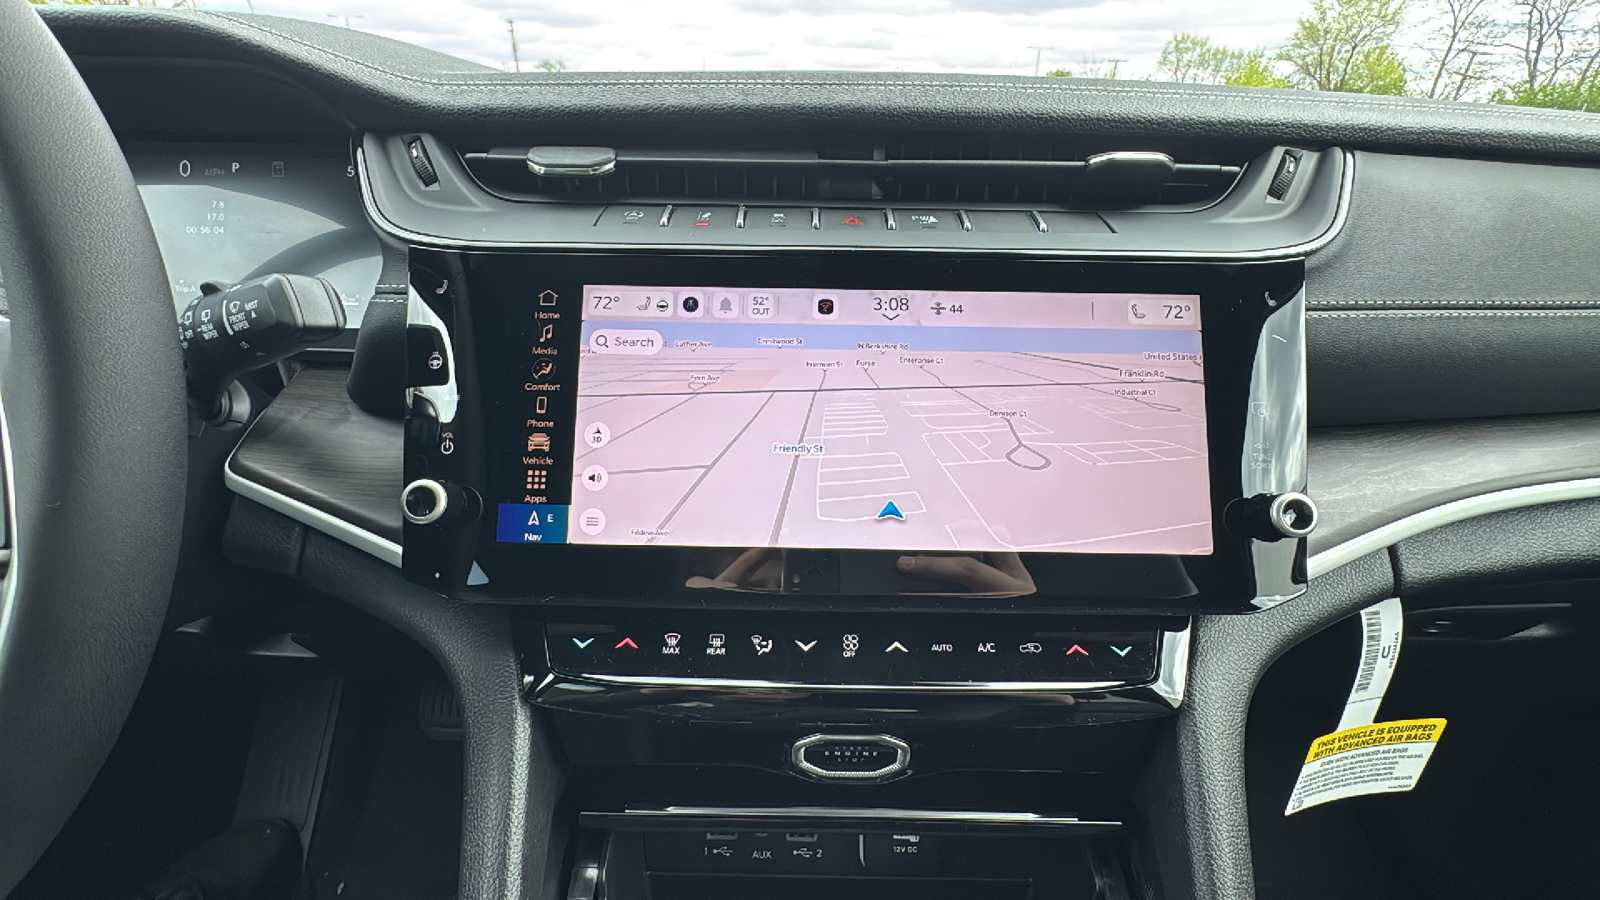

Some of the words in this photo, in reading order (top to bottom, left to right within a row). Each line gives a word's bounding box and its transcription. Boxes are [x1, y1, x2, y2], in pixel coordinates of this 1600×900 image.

[179, 159, 191, 177] 0
[204, 168, 225, 176] MPH
[231, 162, 240, 174] P
[211, 200, 225, 209] 7.8
[206, 212, 225, 221] 17.0
[175, 285, 189, 294] Trip
[190, 285, 197, 293] A
[873, 297, 909, 312] 3:08
[949, 304, 964, 314] 44
[534, 311, 561, 320] Home
[752, 307, 770, 316] OUT
[228, 311, 246, 324] FRONT
[614, 336, 654, 348] Search
[531, 347, 558, 356] Media
[899, 356, 935, 364] Enterprise
[1144, 353, 1171, 361] United
[1172, 353, 1198, 361] States
[1119, 369, 1152, 378] Franklin
[1153, 370, 1165, 378] Rd
[524, 382, 561, 392] Comfort
[989, 409, 1015, 418] Denison
[1017, 409, 1027, 418] Ct
[526, 419, 554, 428] Phone
[591, 436, 602, 444] 3D
[773, 444, 812, 454] Friendly
[813, 444, 824, 454] St
[522, 456, 554, 466] Vehicle
[524, 494, 548, 504] Apps
[547, 514, 554, 522] E
[524, 532, 543, 542] Nav
[662, 646, 681, 655] MAX
[706, 647, 726, 656] REAR
[931, 643, 954, 653] AUTO
[977, 642, 996, 653] A/C
[842, 650, 856, 658] OFF
[1316, 738, 1337, 750] THIS
[1338, 729, 1375, 743] VEHICLE
[1375, 728, 1386, 736] IS
[1386, 724, 1438, 735] EQUIPPED
[1313, 746, 1336, 760] WITH
[1336, 737, 1386, 753] ADVANCED
[1387, 733, 1405, 743] AIR
[1405, 732, 1433, 742] BAGS
[1349, 750, 1381, 760] ADVANCED
[751, 849, 773, 860] AUX
[815, 849, 823, 858] 2
